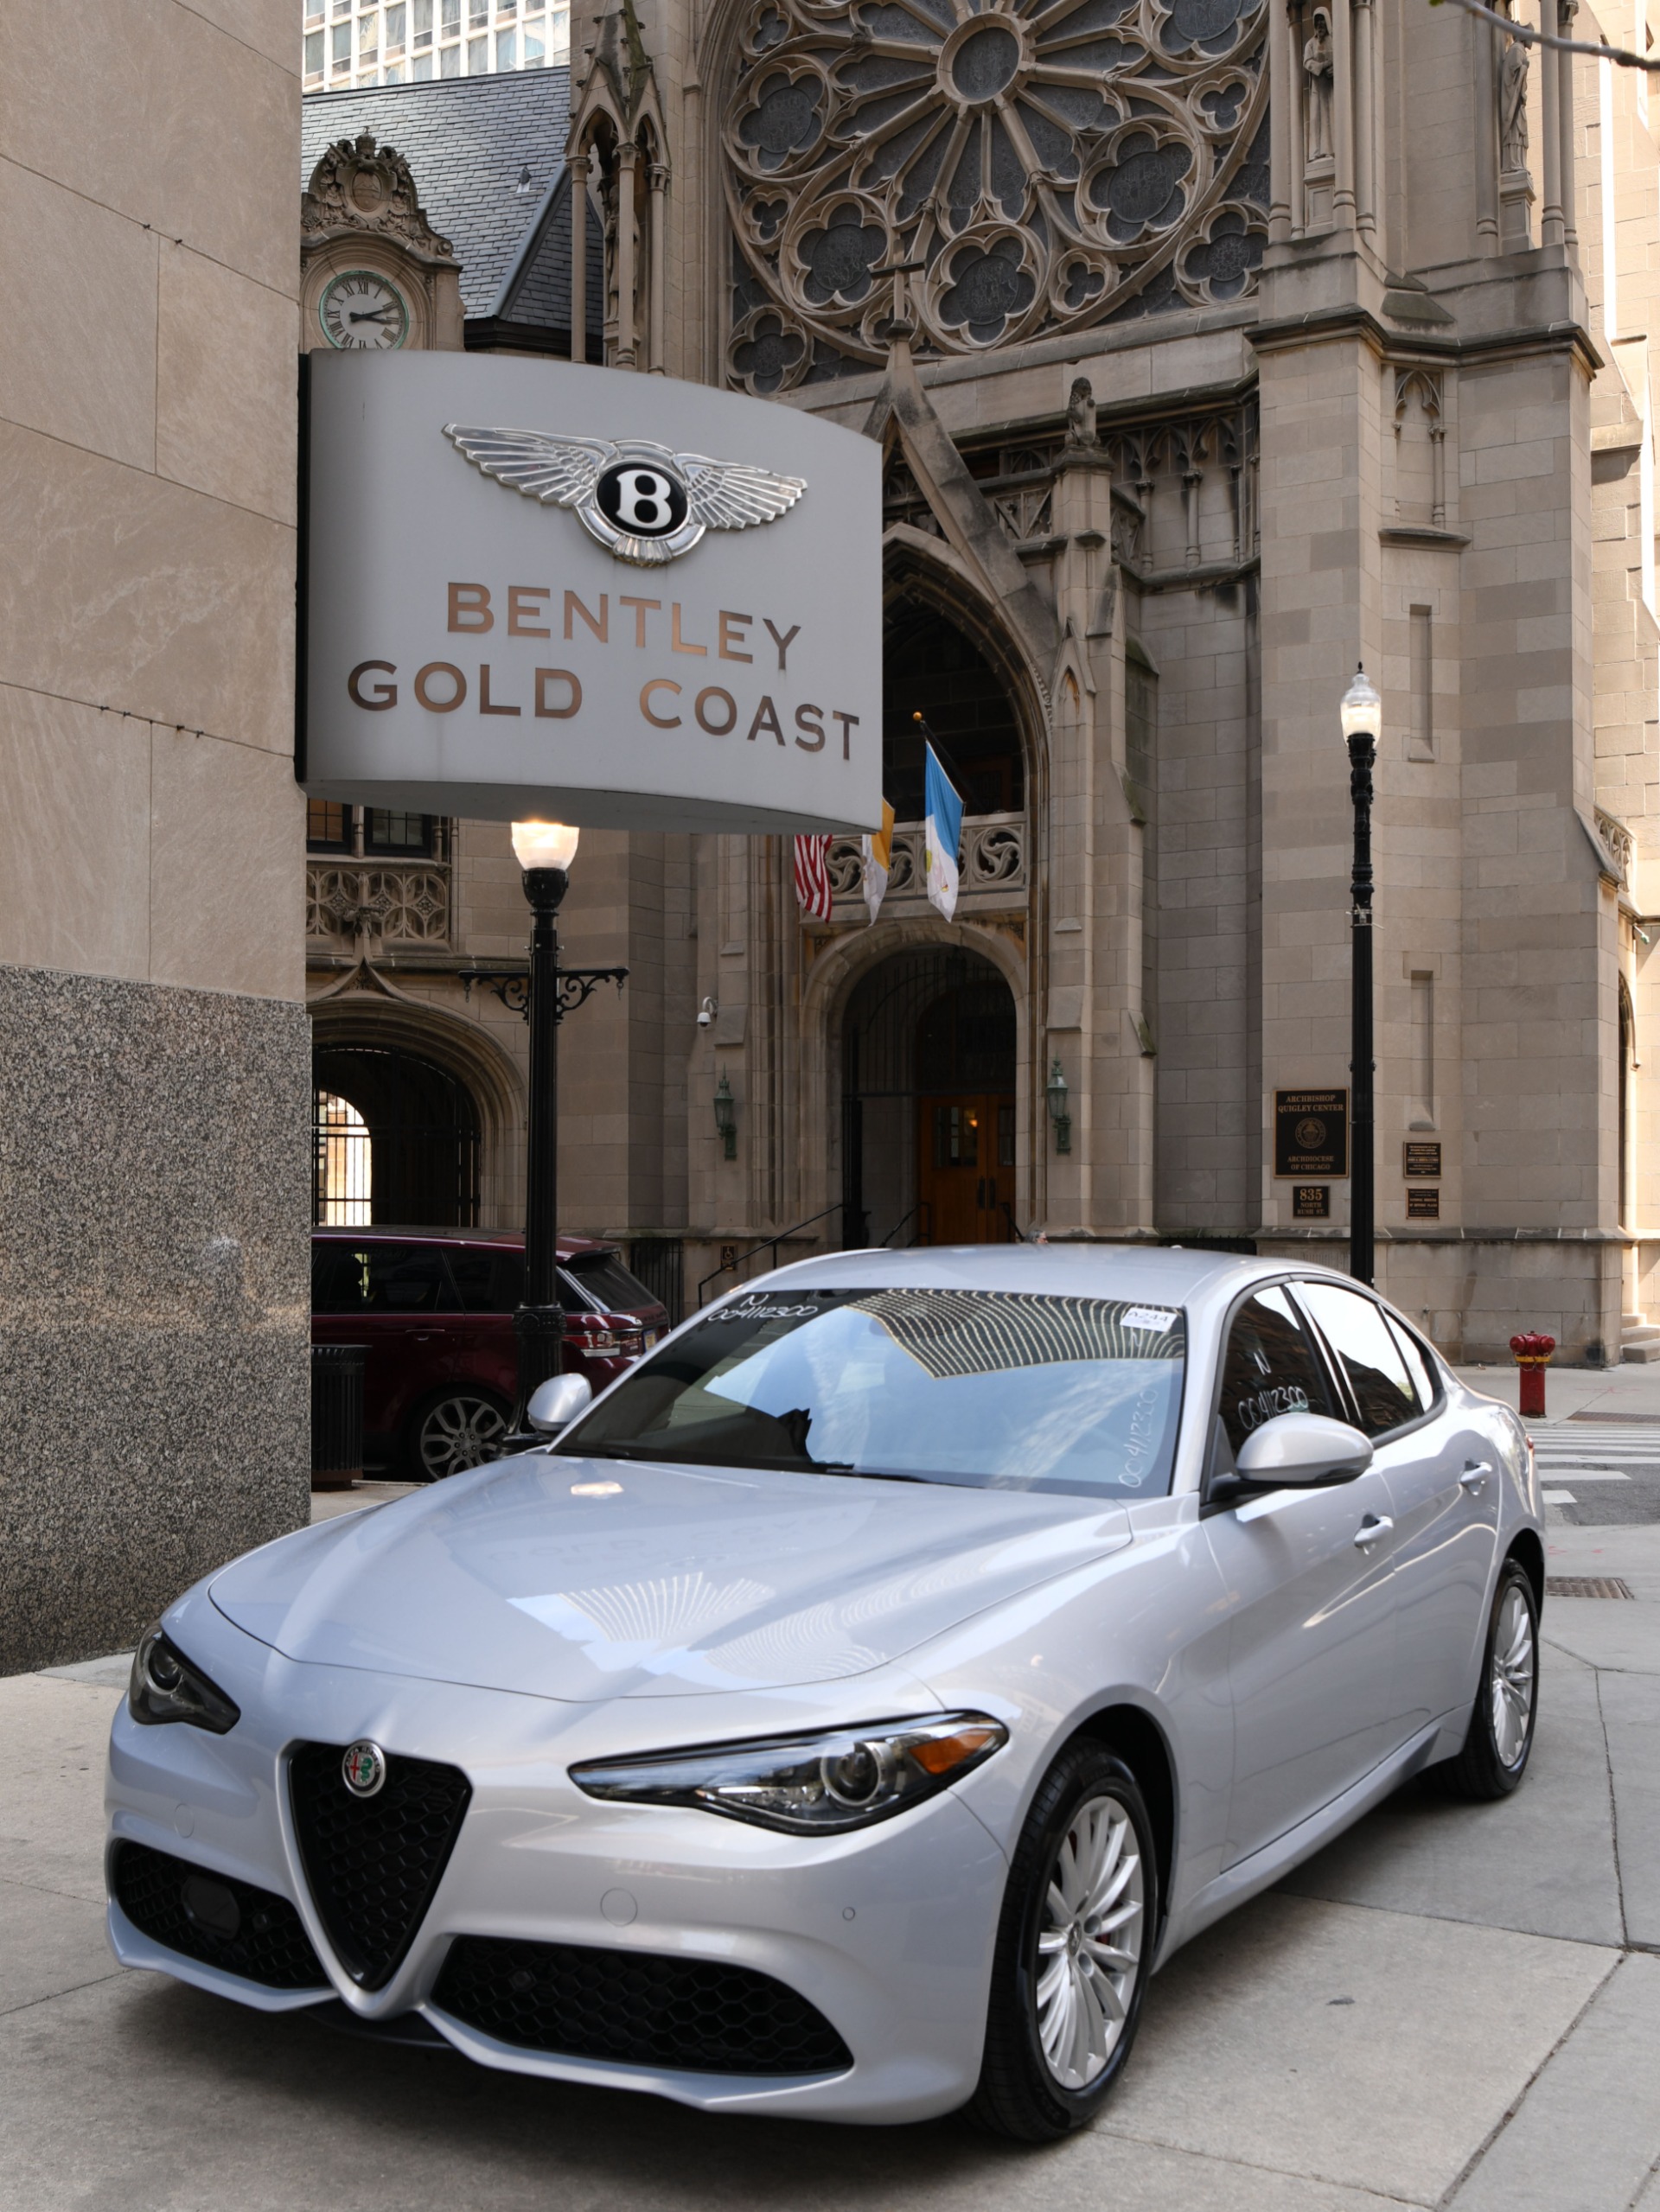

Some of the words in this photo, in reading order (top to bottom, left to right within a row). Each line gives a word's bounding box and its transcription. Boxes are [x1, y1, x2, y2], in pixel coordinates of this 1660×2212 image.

[615, 469, 673, 530] B
[447, 582, 801, 671] BENTLEY
[348, 660, 583, 719] GOLD
[638, 678, 859, 761] COAST
[1278, 1105, 1312, 1113] QUIGLEY
[1286, 1094, 1336, 1103] ARCHBISHOP
[1299, 1188, 1323, 1201] 835
